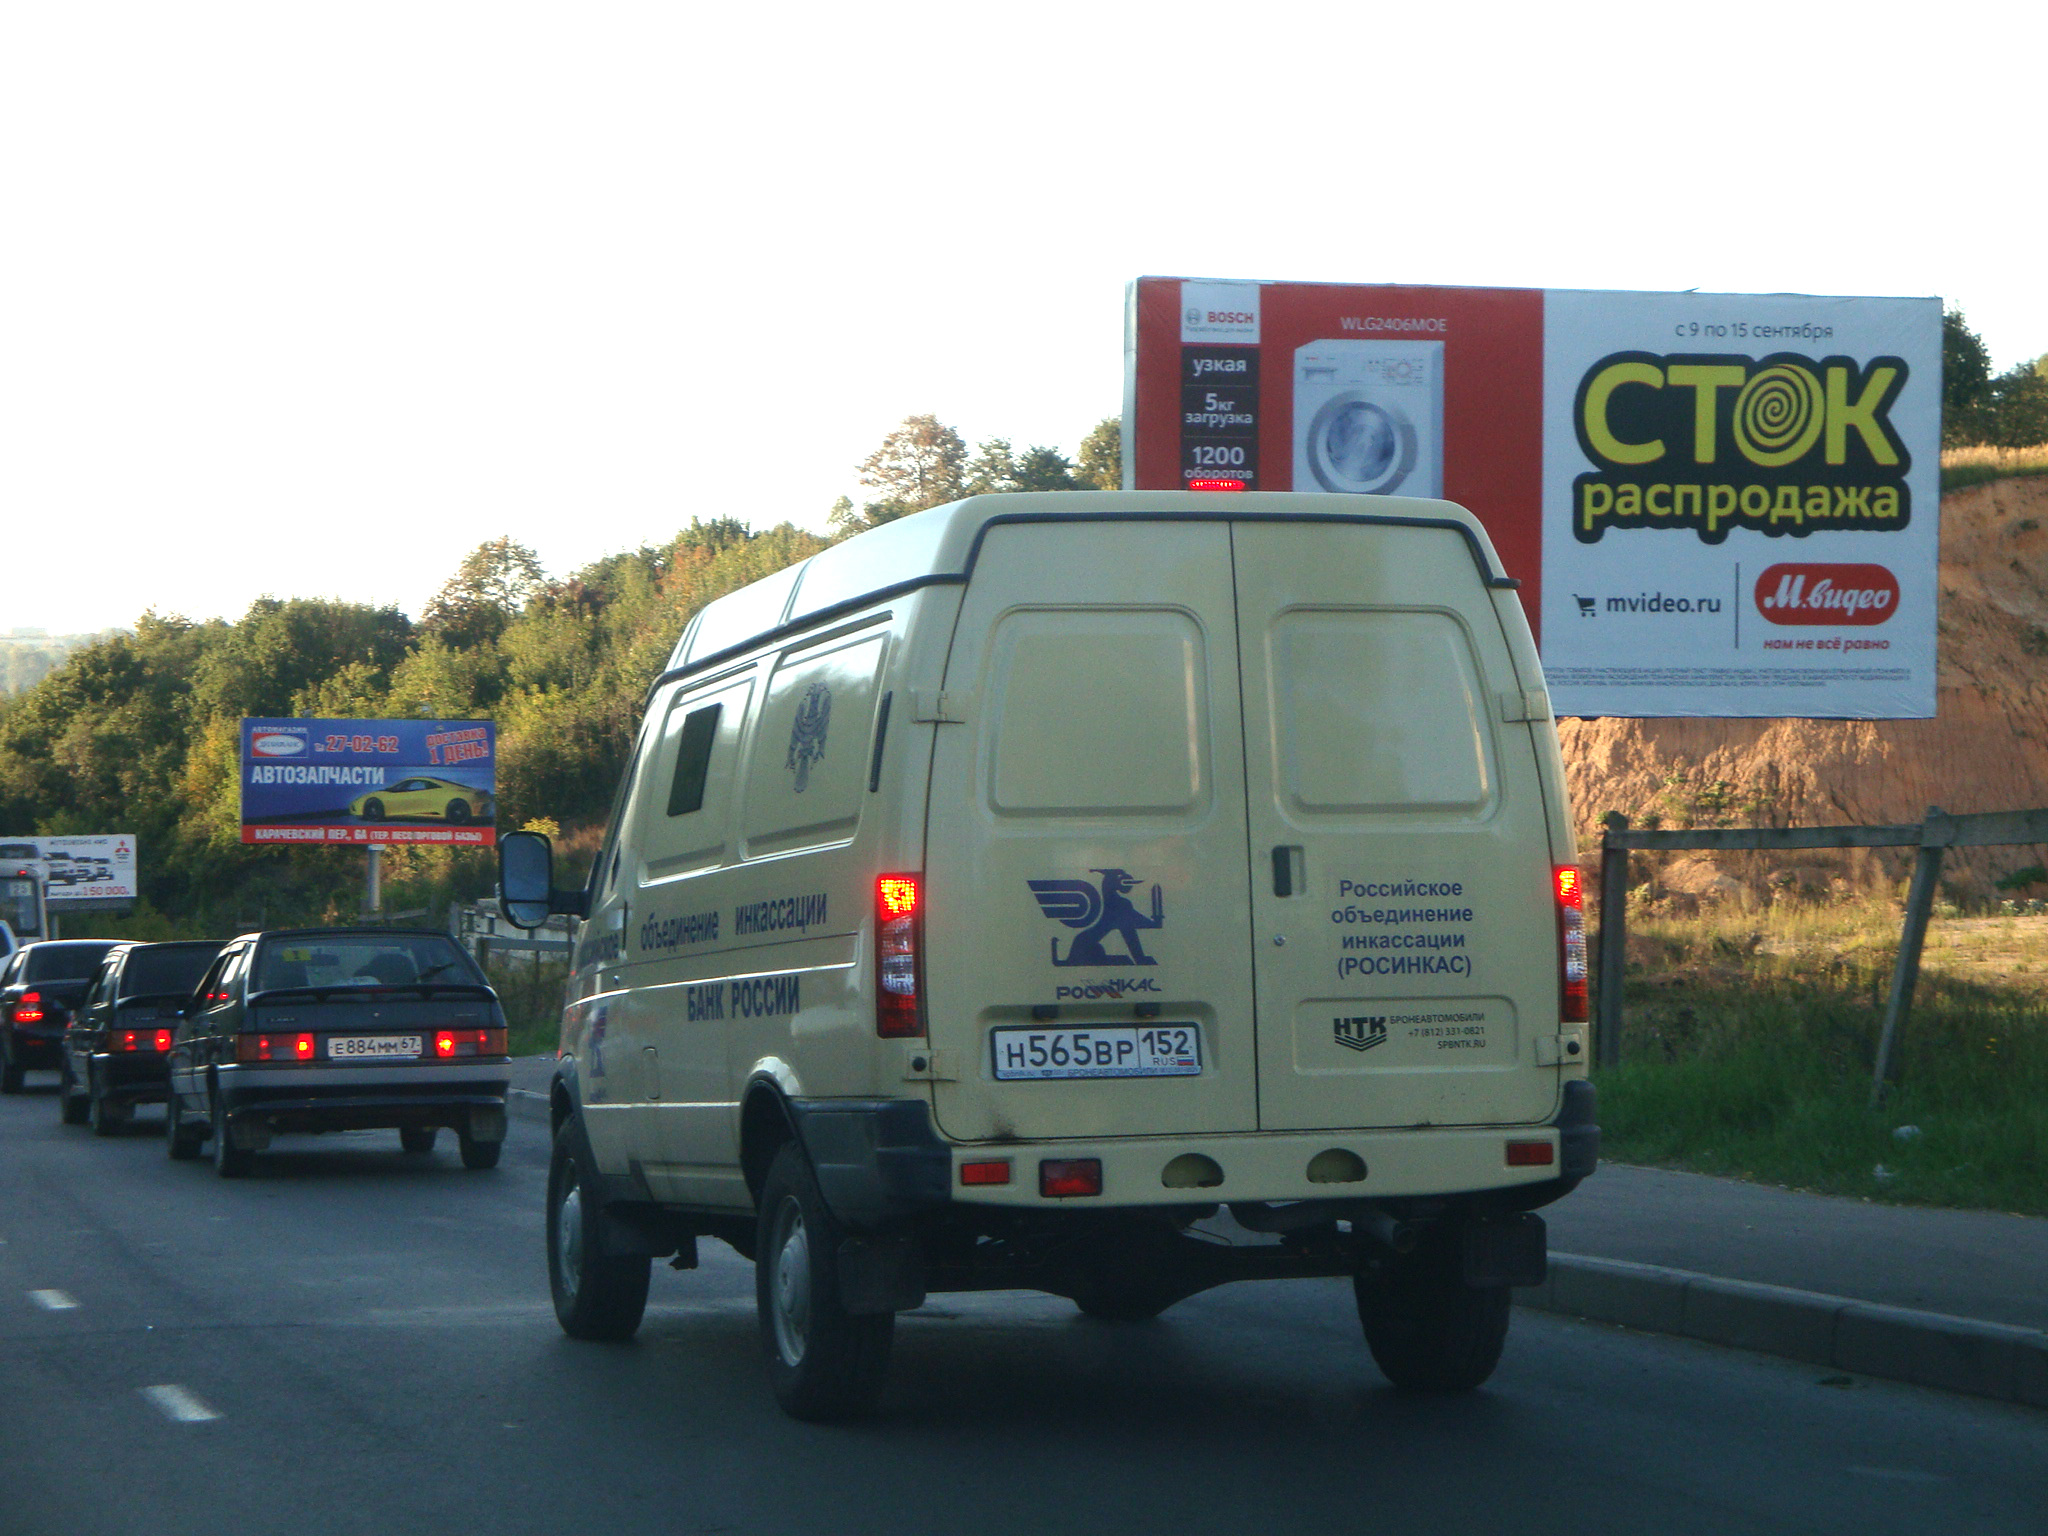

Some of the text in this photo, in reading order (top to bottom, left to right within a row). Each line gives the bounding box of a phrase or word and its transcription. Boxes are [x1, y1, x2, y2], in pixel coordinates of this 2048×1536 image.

[1207, 311, 1254, 324] BOSCH
[1675, 322, 1834, 343] с 9 по 15 сентября
[1192, 358, 1247, 376] узкая
[1185, 413, 1253, 428] загрузка
[1583, 361, 1899, 468] СТОК
[1192, 446, 1245, 465] 1200
[1184, 466, 1254, 480] оборотов
[1583, 482, 1899, 532] распродажа
[1606, 592, 1721, 613] mvideo.ru
[1763, 636, 1891, 654] нам не всё равно
[326, 735, 399, 752] 27-02-62
[430, 740, 489, 765] 1 ДЕНЬ!
[252, 766, 385, 784] АВТОЗАПЧАСТИ
[83, 886, 103, 896] 150
[1339, 879, 1463, 897] Российское
[640, 911, 719, 951] объединение
[736, 893, 827, 935] инкассации
[1331, 906, 1473, 925] объединение
[1342, 933, 1465, 950] инкассации
[1337, 955, 1472, 980] (РОСИНКАС)
[687, 975, 800, 1021] БАНК РОССИИ
[1333, 1012, 1485, 1038] НТК БРОНЕАВТОМОБИЛИ
[1421, 1027, 1443, 1037] (812)
[401, 1037, 416, 1049] 67
[1141, 1030, 1190, 1055] 152
[1153, 1056, 1176, 1066] RUS
